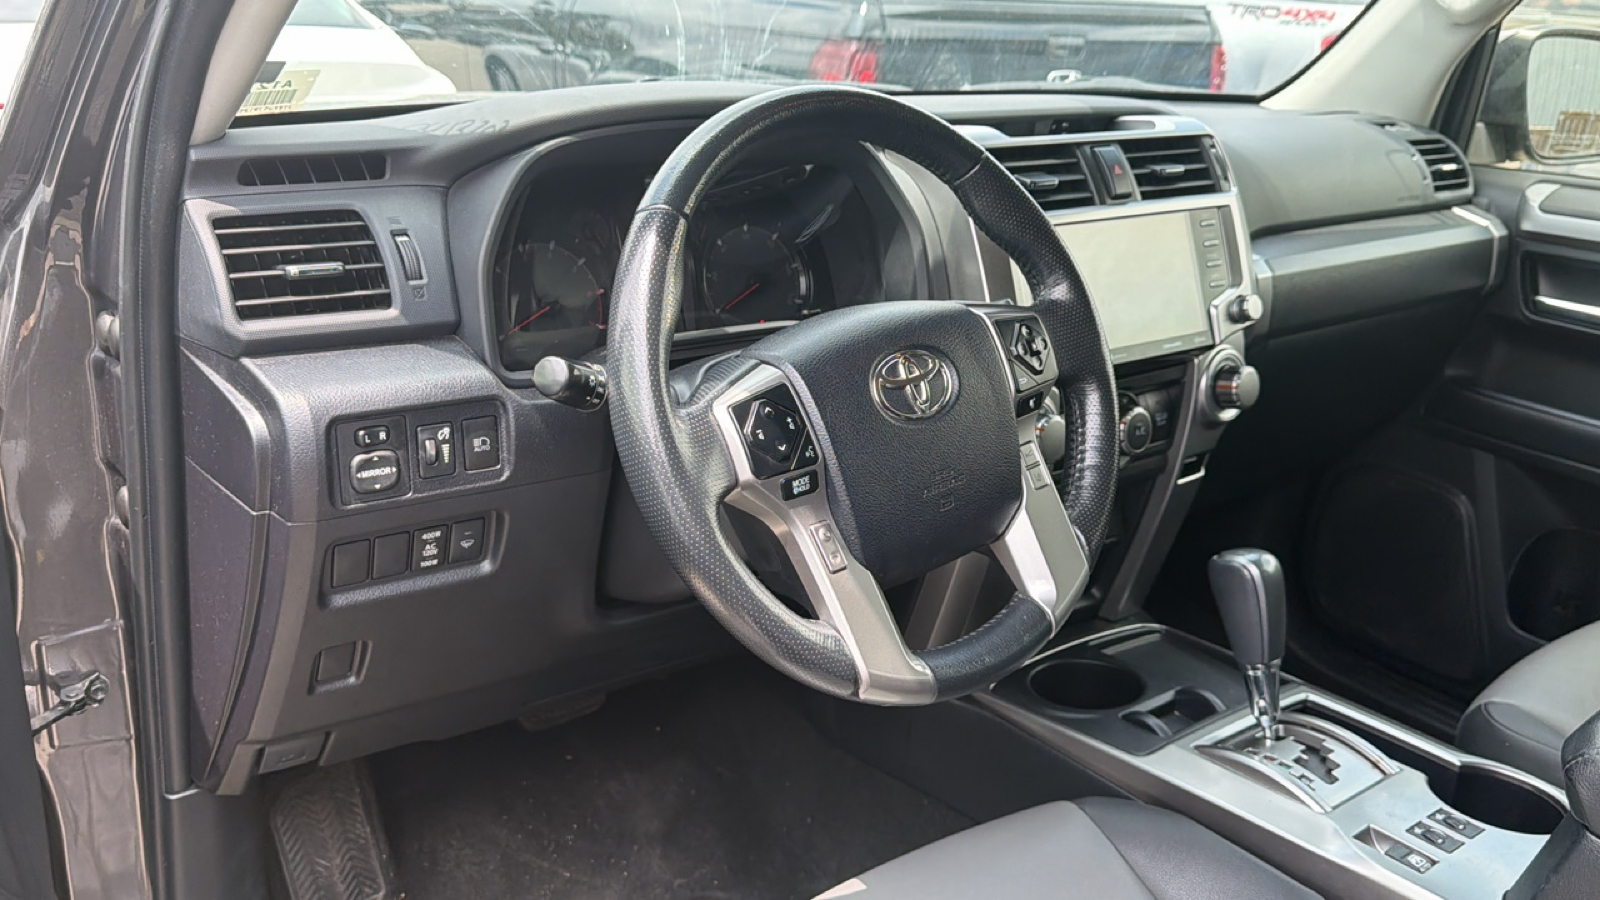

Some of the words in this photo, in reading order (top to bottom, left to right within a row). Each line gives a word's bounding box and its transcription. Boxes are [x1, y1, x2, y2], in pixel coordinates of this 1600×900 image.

[364, 434, 371, 443] L
[379, 430, 387, 440] R
[360, 465, 392, 479] MIRROR
